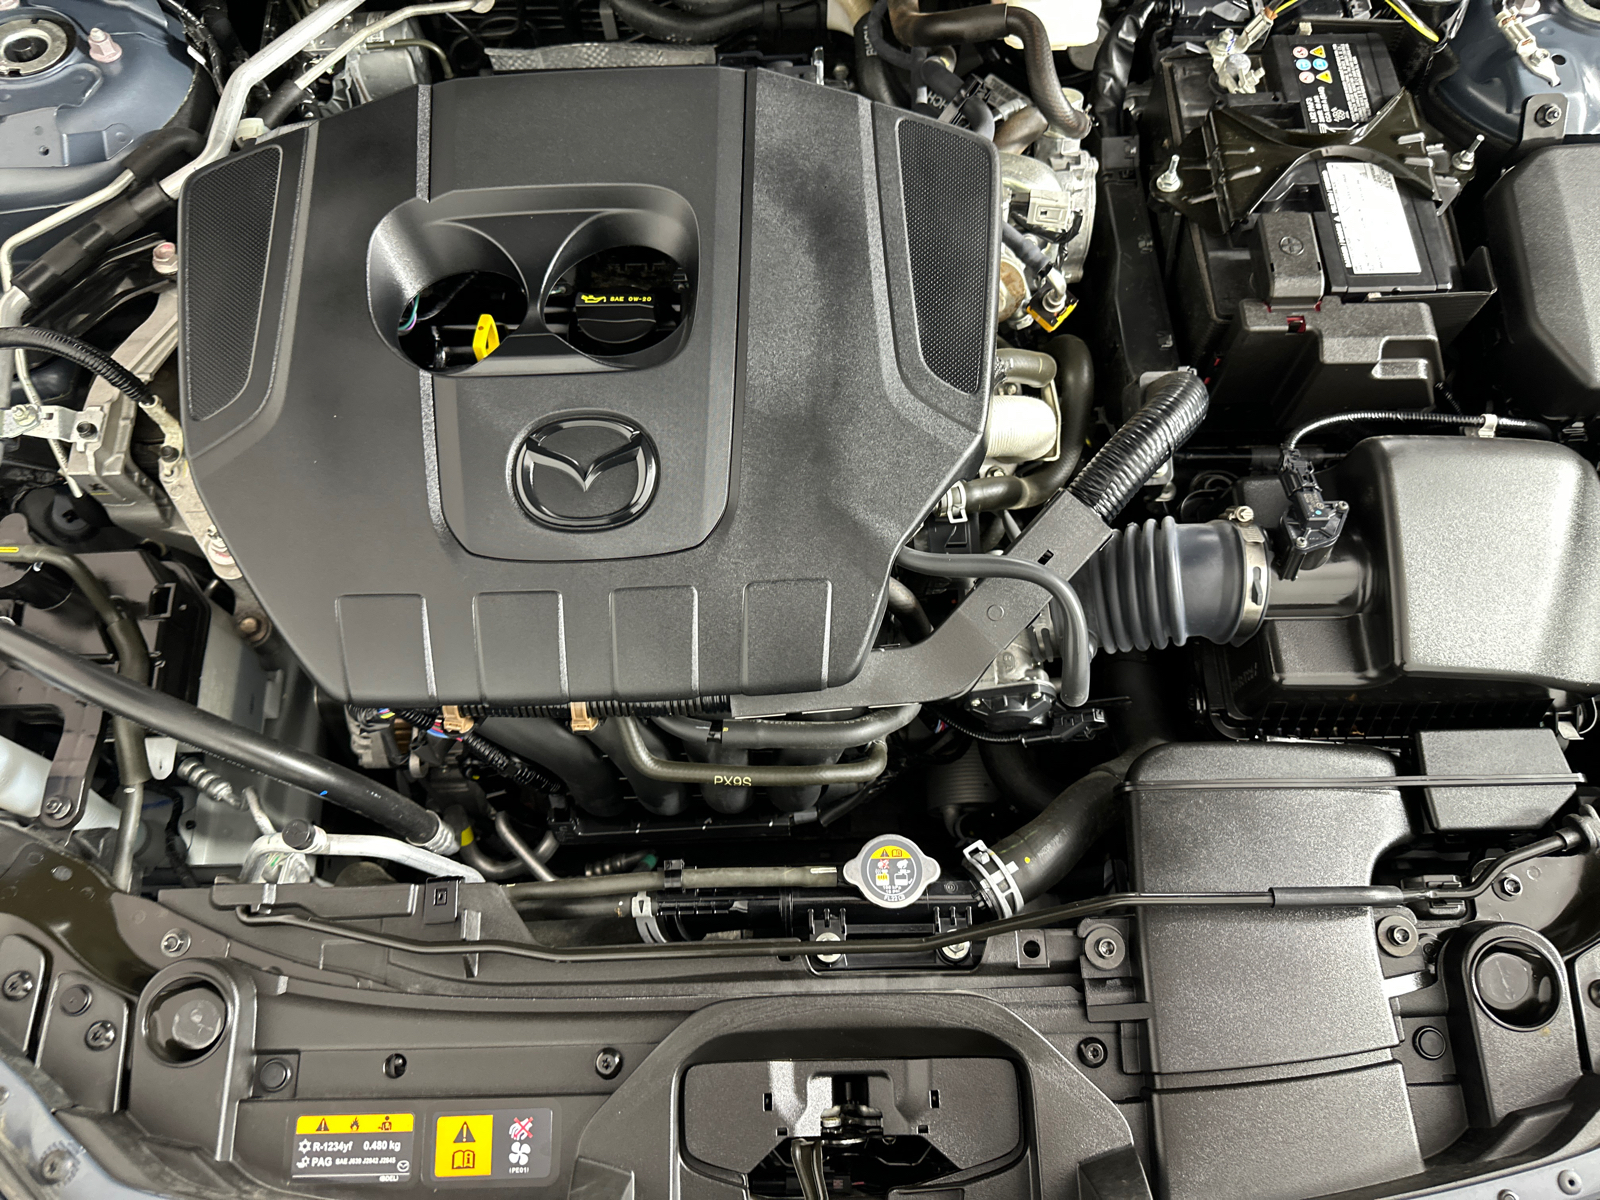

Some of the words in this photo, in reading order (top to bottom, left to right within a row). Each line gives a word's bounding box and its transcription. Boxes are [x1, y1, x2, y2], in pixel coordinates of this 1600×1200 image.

[312, 1141, 353, 1153] R-1234yf
[363, 1141, 387, 1151] 0.480
[389, 1140, 401, 1152] kg
[311, 1157, 332, 1167] PAG
